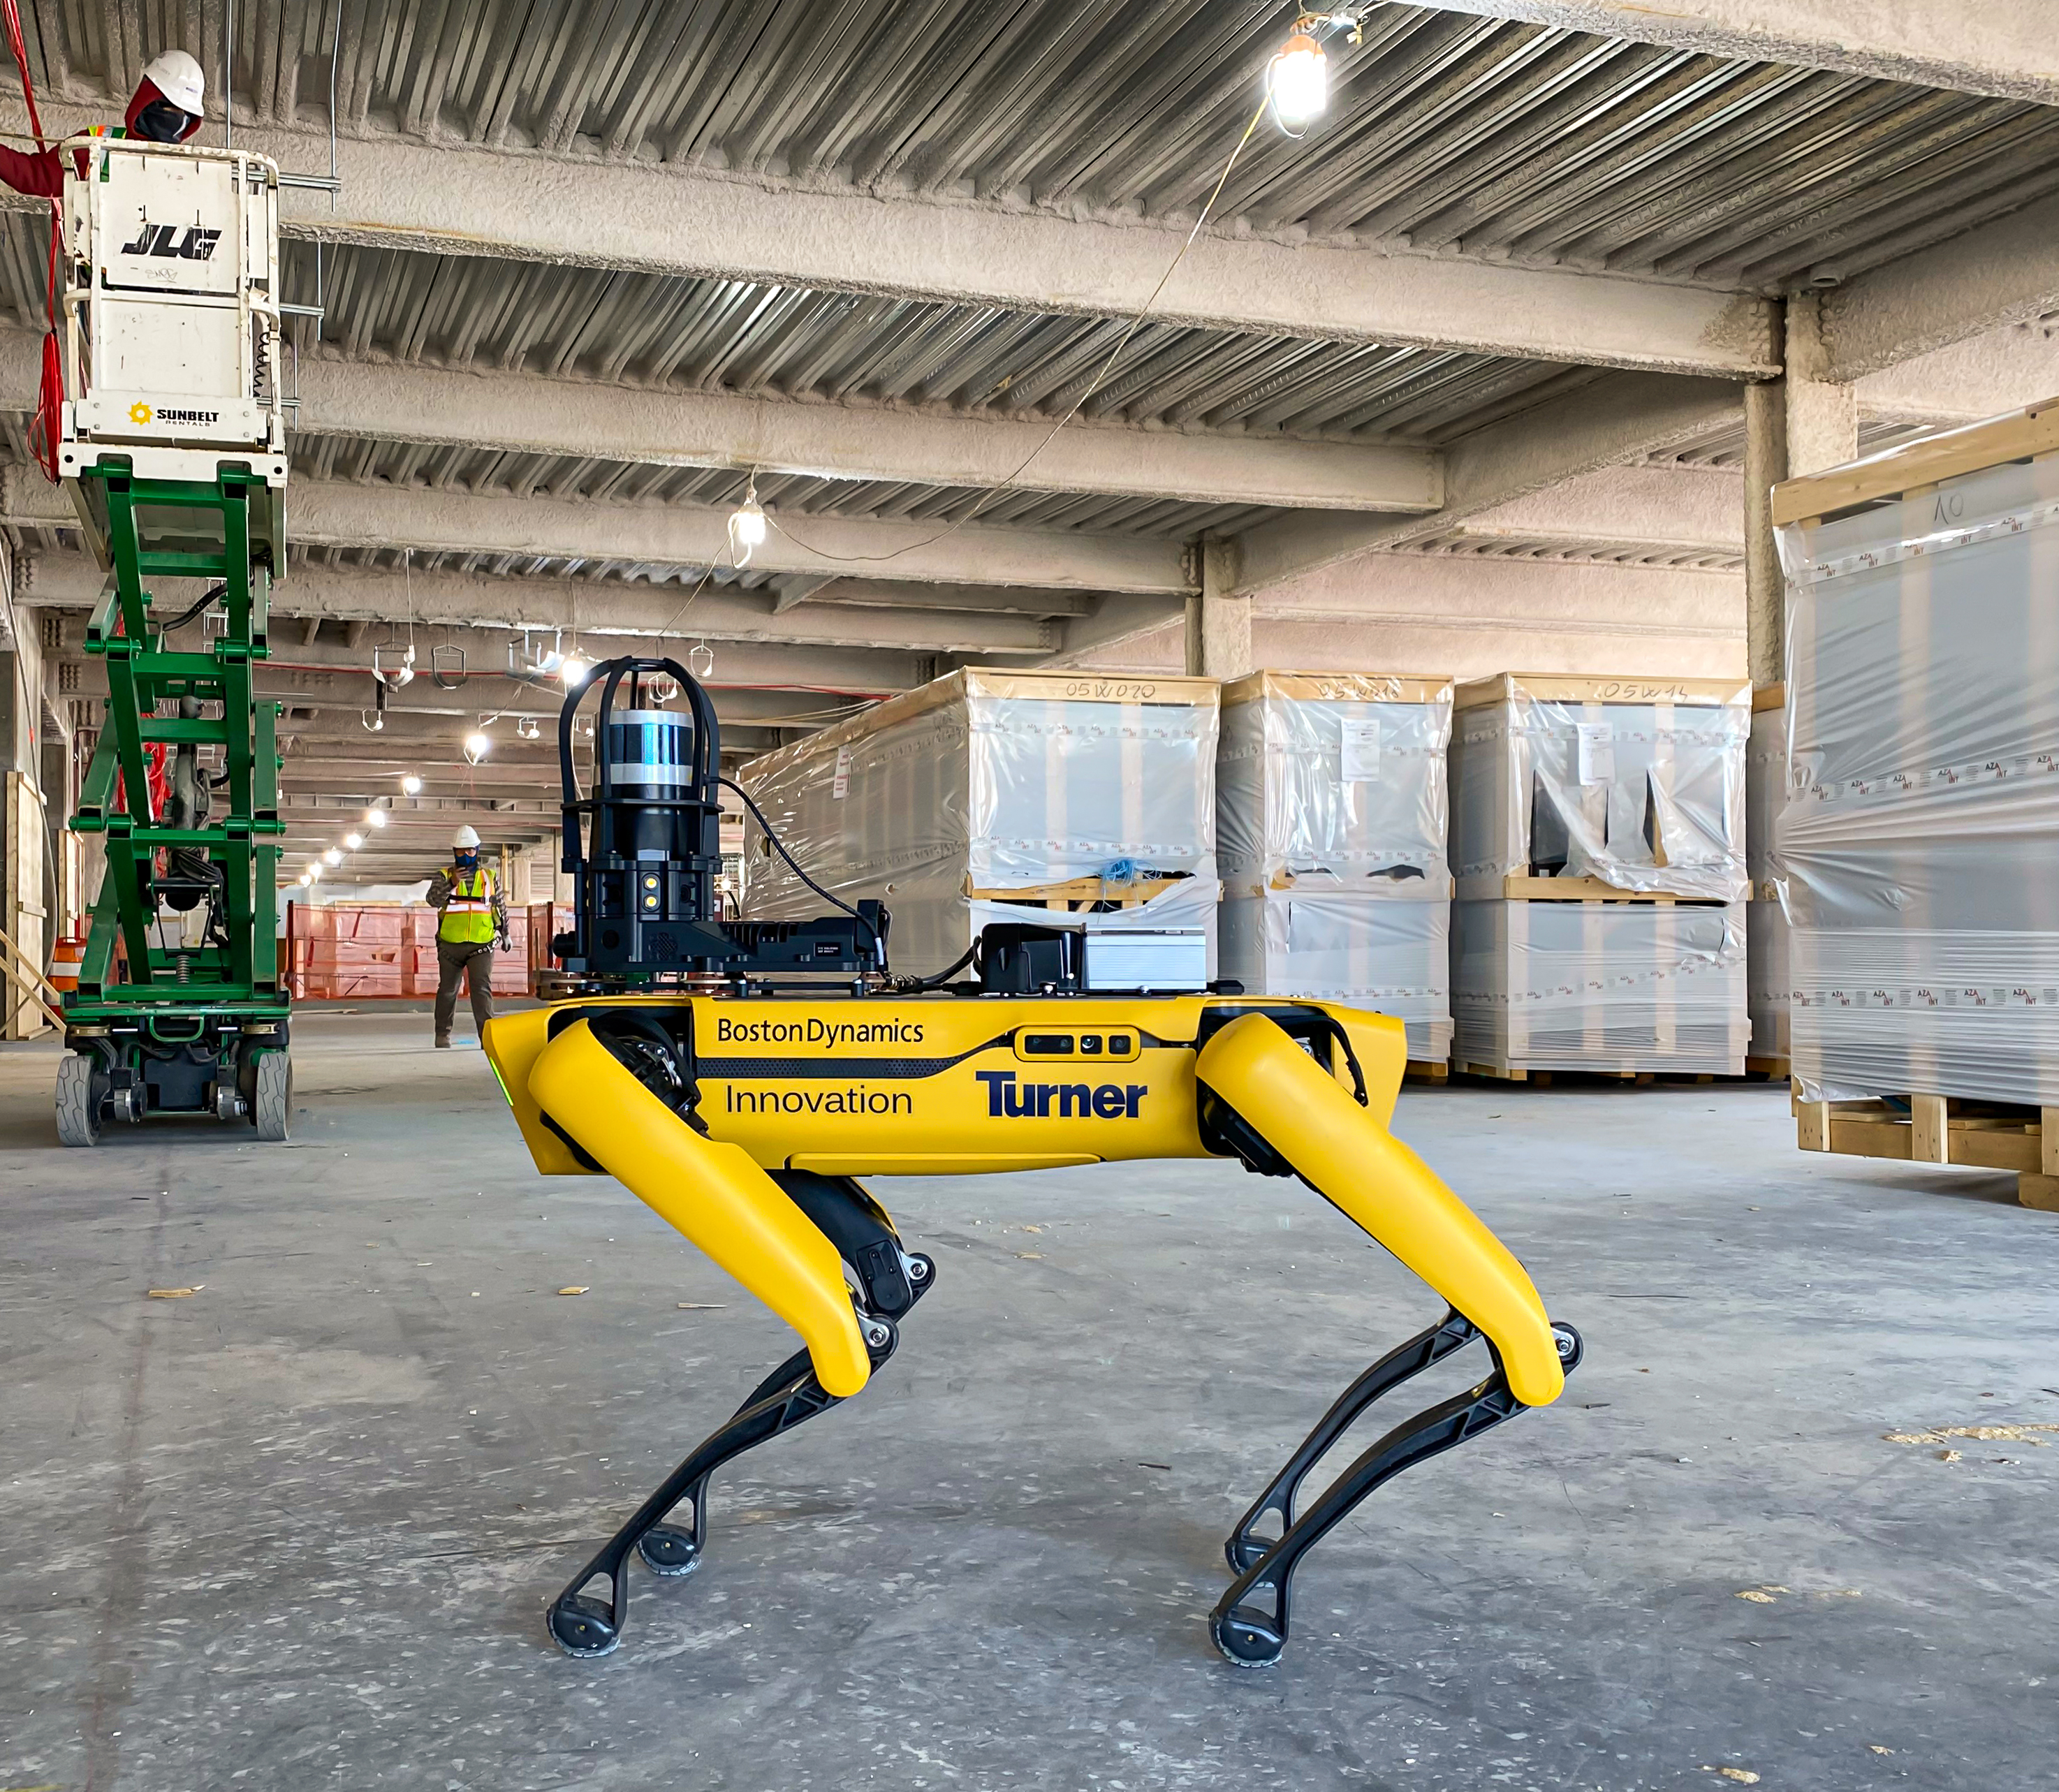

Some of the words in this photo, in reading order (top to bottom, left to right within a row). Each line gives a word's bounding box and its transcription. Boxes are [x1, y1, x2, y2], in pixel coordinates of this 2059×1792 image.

[121, 224, 222, 260] JLG
[157, 409, 219, 422] SUNBELT
[1869, 559, 1878, 567] INT
[1914, 547, 1924, 556] INT
[1961, 535, 1972, 544] INT
[2012, 522, 2023, 532] INT
[726, 1085, 911, 1114] Innovation
[976, 1071, 1148, 1118] Turner
